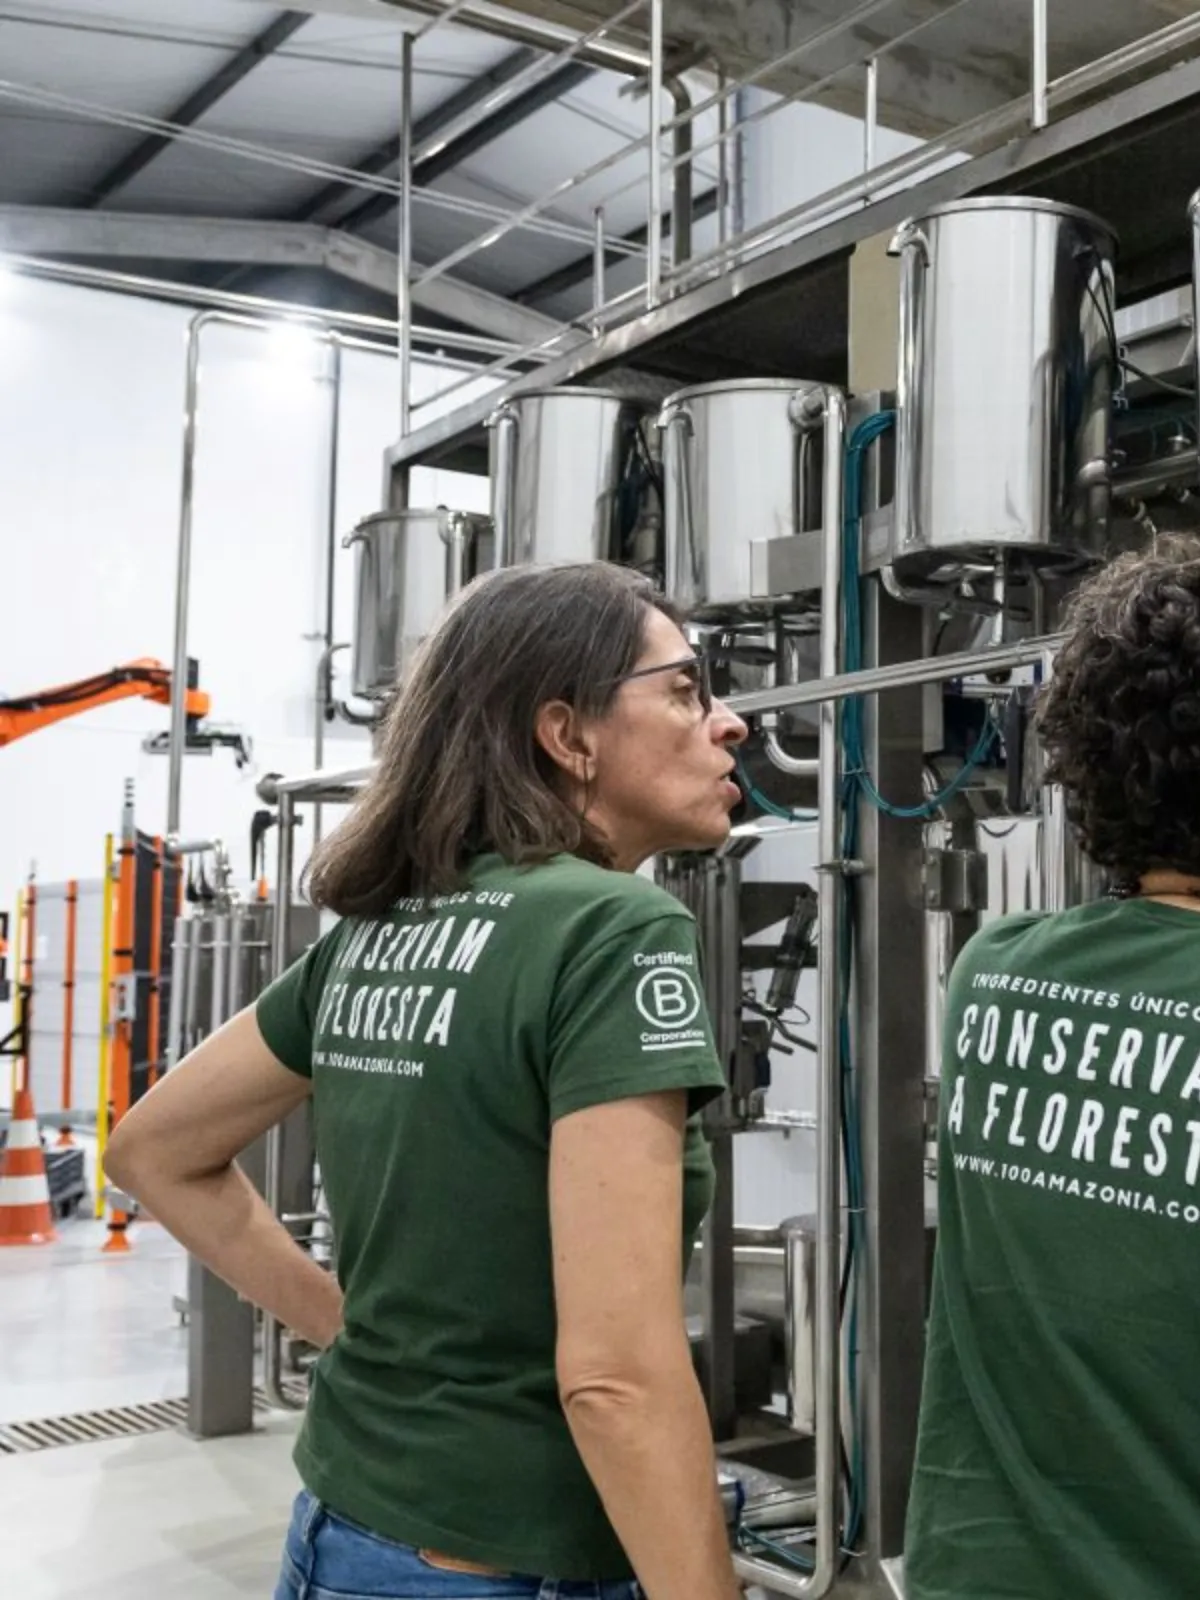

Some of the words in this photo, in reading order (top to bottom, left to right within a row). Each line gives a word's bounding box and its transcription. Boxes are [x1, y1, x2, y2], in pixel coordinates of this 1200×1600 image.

[475, 891, 515, 908] QUE
[633, 951, 694, 967] Certified
[972, 973, 1120, 1008] INGREDIENTES
[318, 983, 457, 1047] FLORESTA
[640, 1029, 705, 1044] Corporation
[948, 1075, 967, 1135] A
